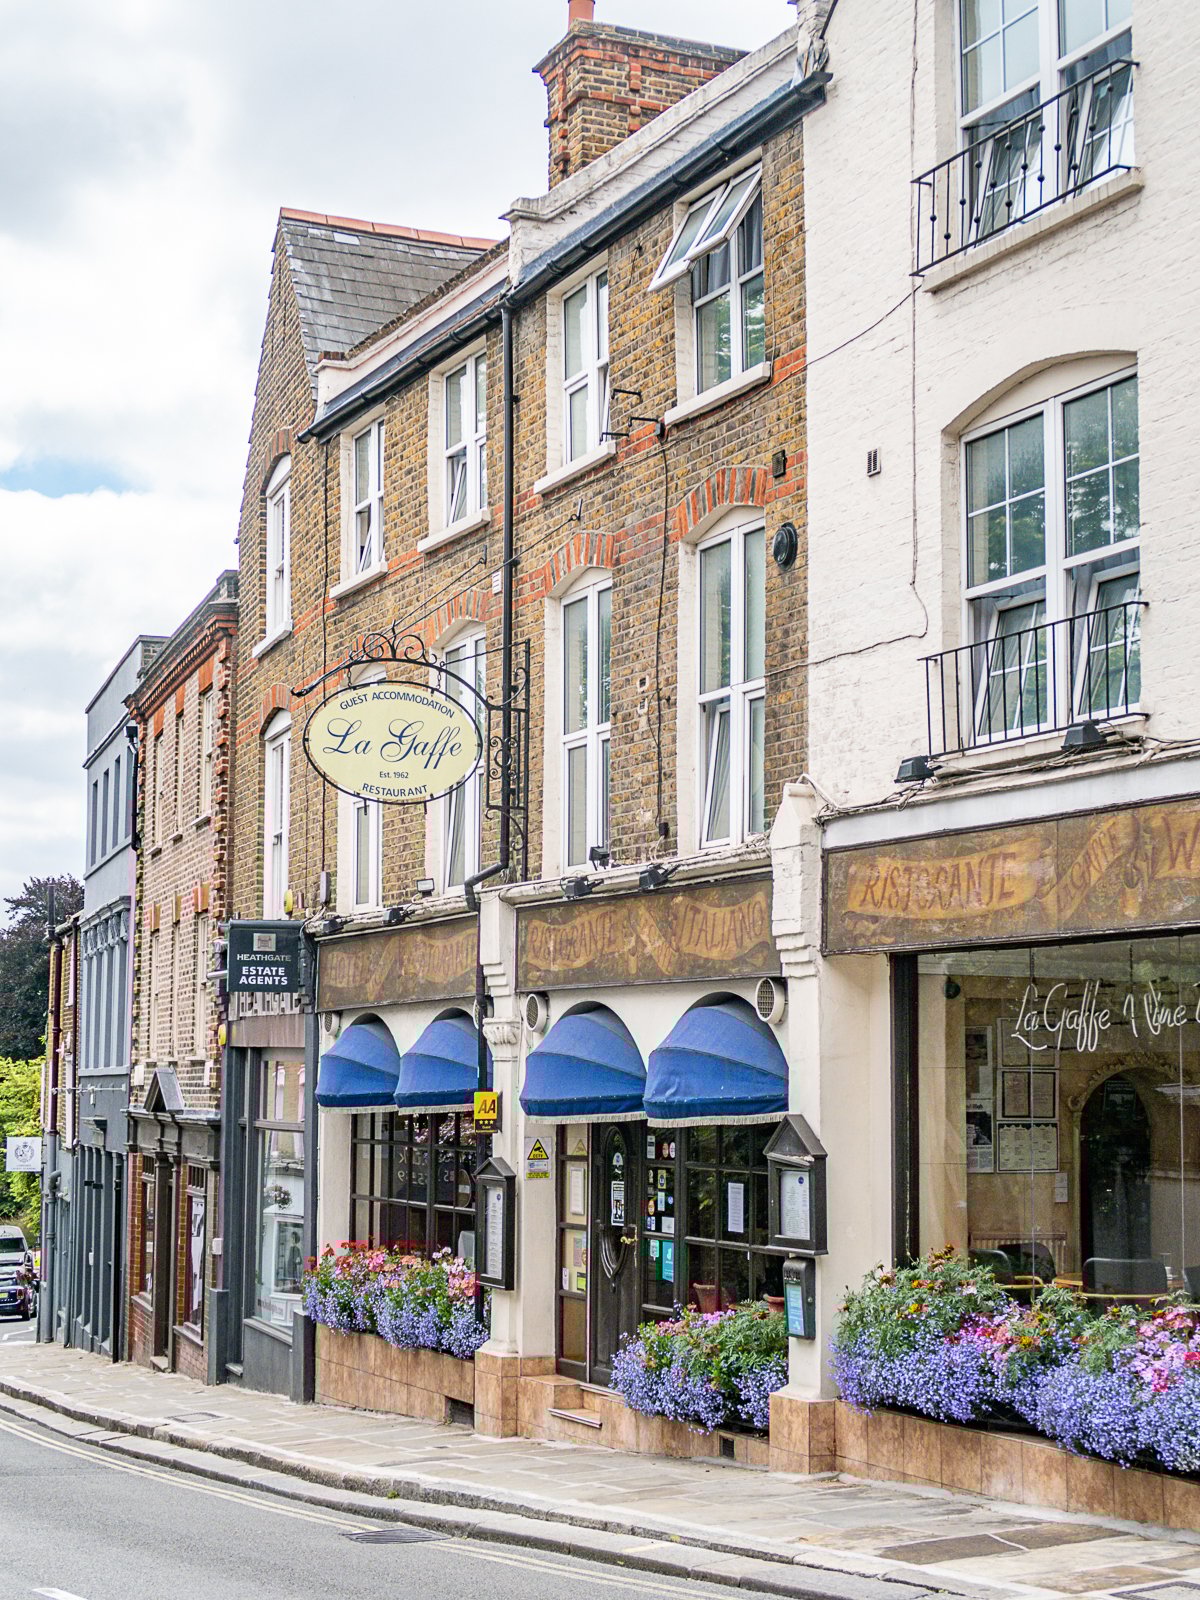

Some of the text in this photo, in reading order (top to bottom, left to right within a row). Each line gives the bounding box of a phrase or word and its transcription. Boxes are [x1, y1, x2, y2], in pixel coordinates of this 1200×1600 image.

[339, 691, 455, 719] GUEST ACCOMMODATION
[322, 717, 463, 770] La Gaffe
[379, 771, 409, 779] Est. 1962
[362, 783, 428, 797] RESTAURANT
[859, 852, 1016, 912] RISTORANTE
[530, 910, 617, 961] RISTORANTE
[680, 901, 764, 953] ITALIANO
[237, 953, 292, 962] HEATHGATE
[239, 976, 288, 986] AGENTS
[242, 966, 285, 976] ESTATE
[1011, 983, 1047, 1050] La
[1044, 980, 1110, 1052] Gaffe
[478, 1099, 496, 1114] AA
